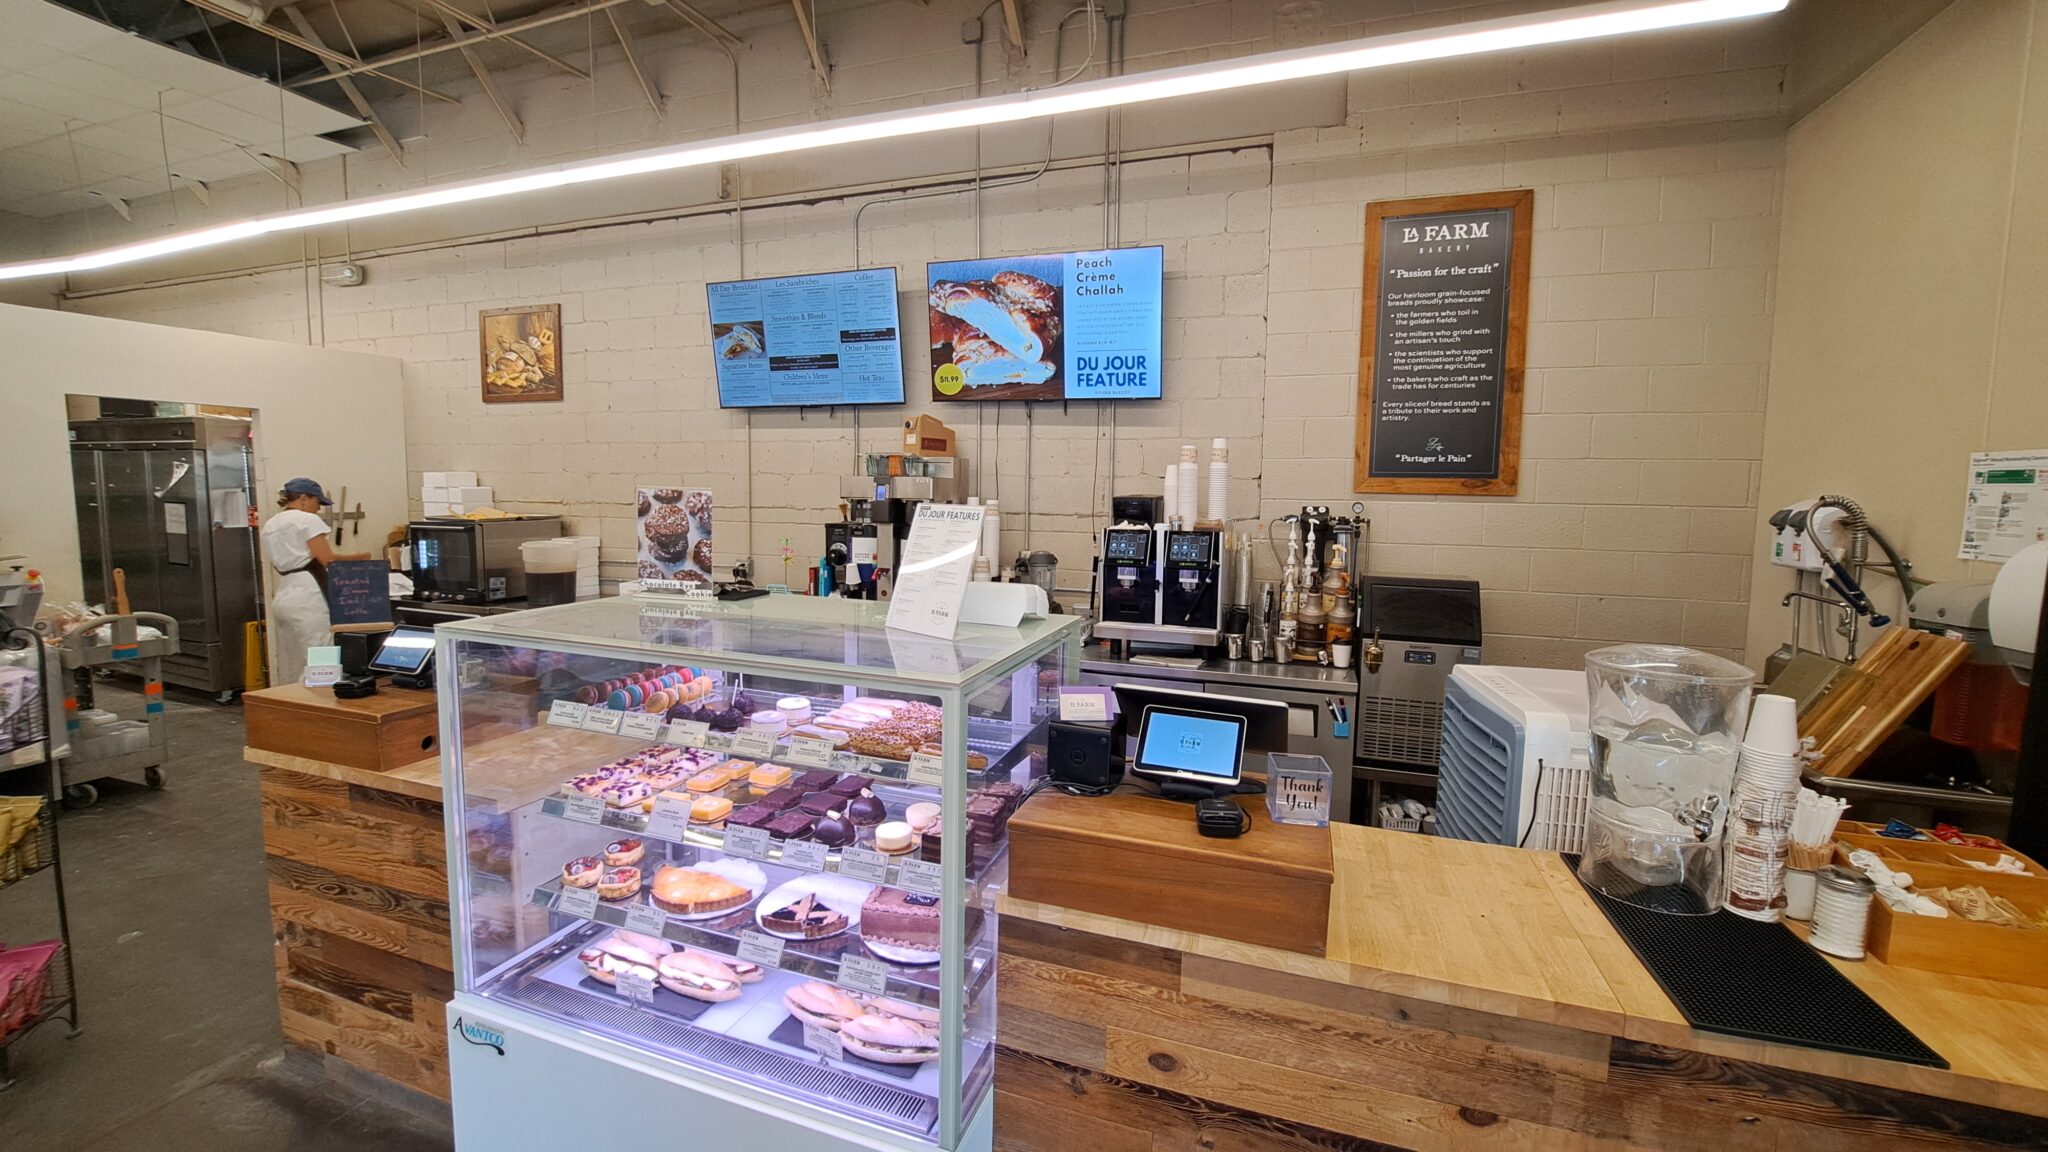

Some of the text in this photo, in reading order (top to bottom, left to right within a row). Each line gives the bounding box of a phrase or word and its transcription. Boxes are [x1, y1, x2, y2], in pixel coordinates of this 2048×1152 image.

[1424, 222, 1489, 241] FARM
[1419, 245, 1470, 254] BAKERY
[1076, 257, 1112, 268] Peach
[1435, 267, 1448, 276] for
[1451, 266, 1466, 275] the
[855, 273, 874, 281] Coffee
[1076, 272, 1116, 282] Crème
[787, 278, 819, 287] Sandwiches
[720, 285, 730, 294] Day
[732, 283, 758, 291] Breakfast
[1076, 285, 1124, 296] Challah
[1438, 288, 1490, 298] grain-focused
[1415, 298, 1443, 306] proudly
[772, 314, 800, 322] Smoothies
[807, 312, 826, 320] Blends
[1409, 318, 1435, 326] golden
[1453, 329, 1472, 337] grind
[864, 343, 894, 352] Beverages
[1463, 348, 1493, 356] support
[1077, 356, 1147, 370] DU JOUR
[1413, 363, 1443, 371] genuine
[1445, 362, 1486, 370] agriculture
[859, 374, 872, 382] Hot
[940, 375, 959, 383] $11.99
[1078, 372, 1146, 387] FEATURE
[928, 510, 945, 518] JOUR
[947, 511, 980, 520] FEATURES
[680, 582, 694, 590] Rye
[1280, 776, 1324, 793] Thank
[1286, 793, 1318, 811] You!
